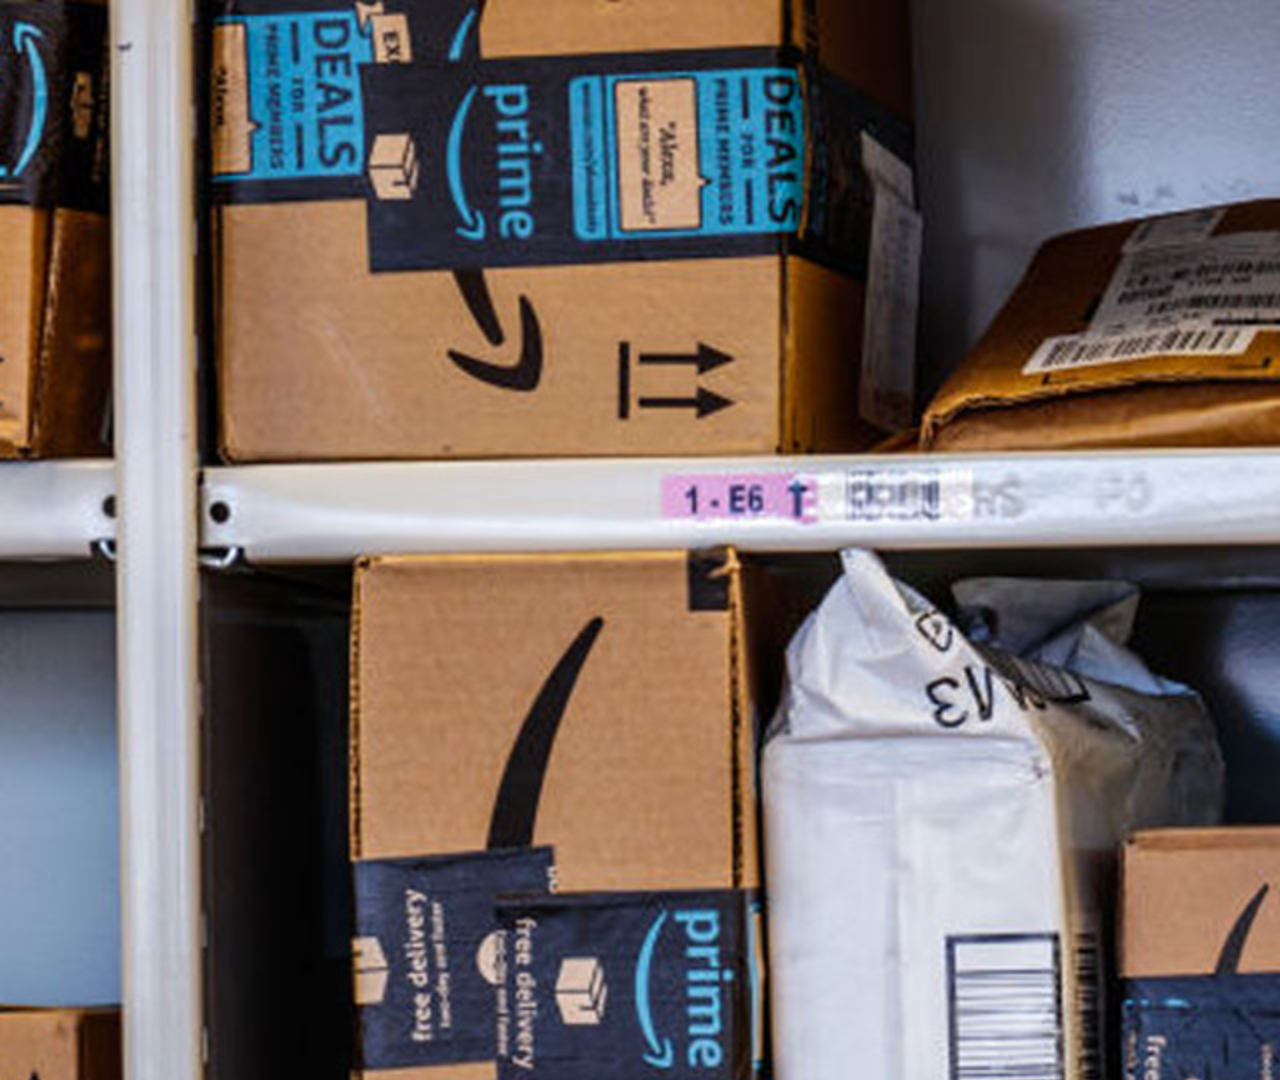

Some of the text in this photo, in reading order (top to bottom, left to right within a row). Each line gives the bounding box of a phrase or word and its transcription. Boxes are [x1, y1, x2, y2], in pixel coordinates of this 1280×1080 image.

[313, 18, 356, 168] DEALS
[484, 84, 543, 239] prime
[712, 78, 732, 224] PRIME MEMBERS
[763, 76, 797, 223] DEALS
[730, 486, 763, 513] E6
[405, 889, 432, 1041] free delivery
[513, 918, 538, 1069] free delivery
[673, 908, 735, 1068] prime
